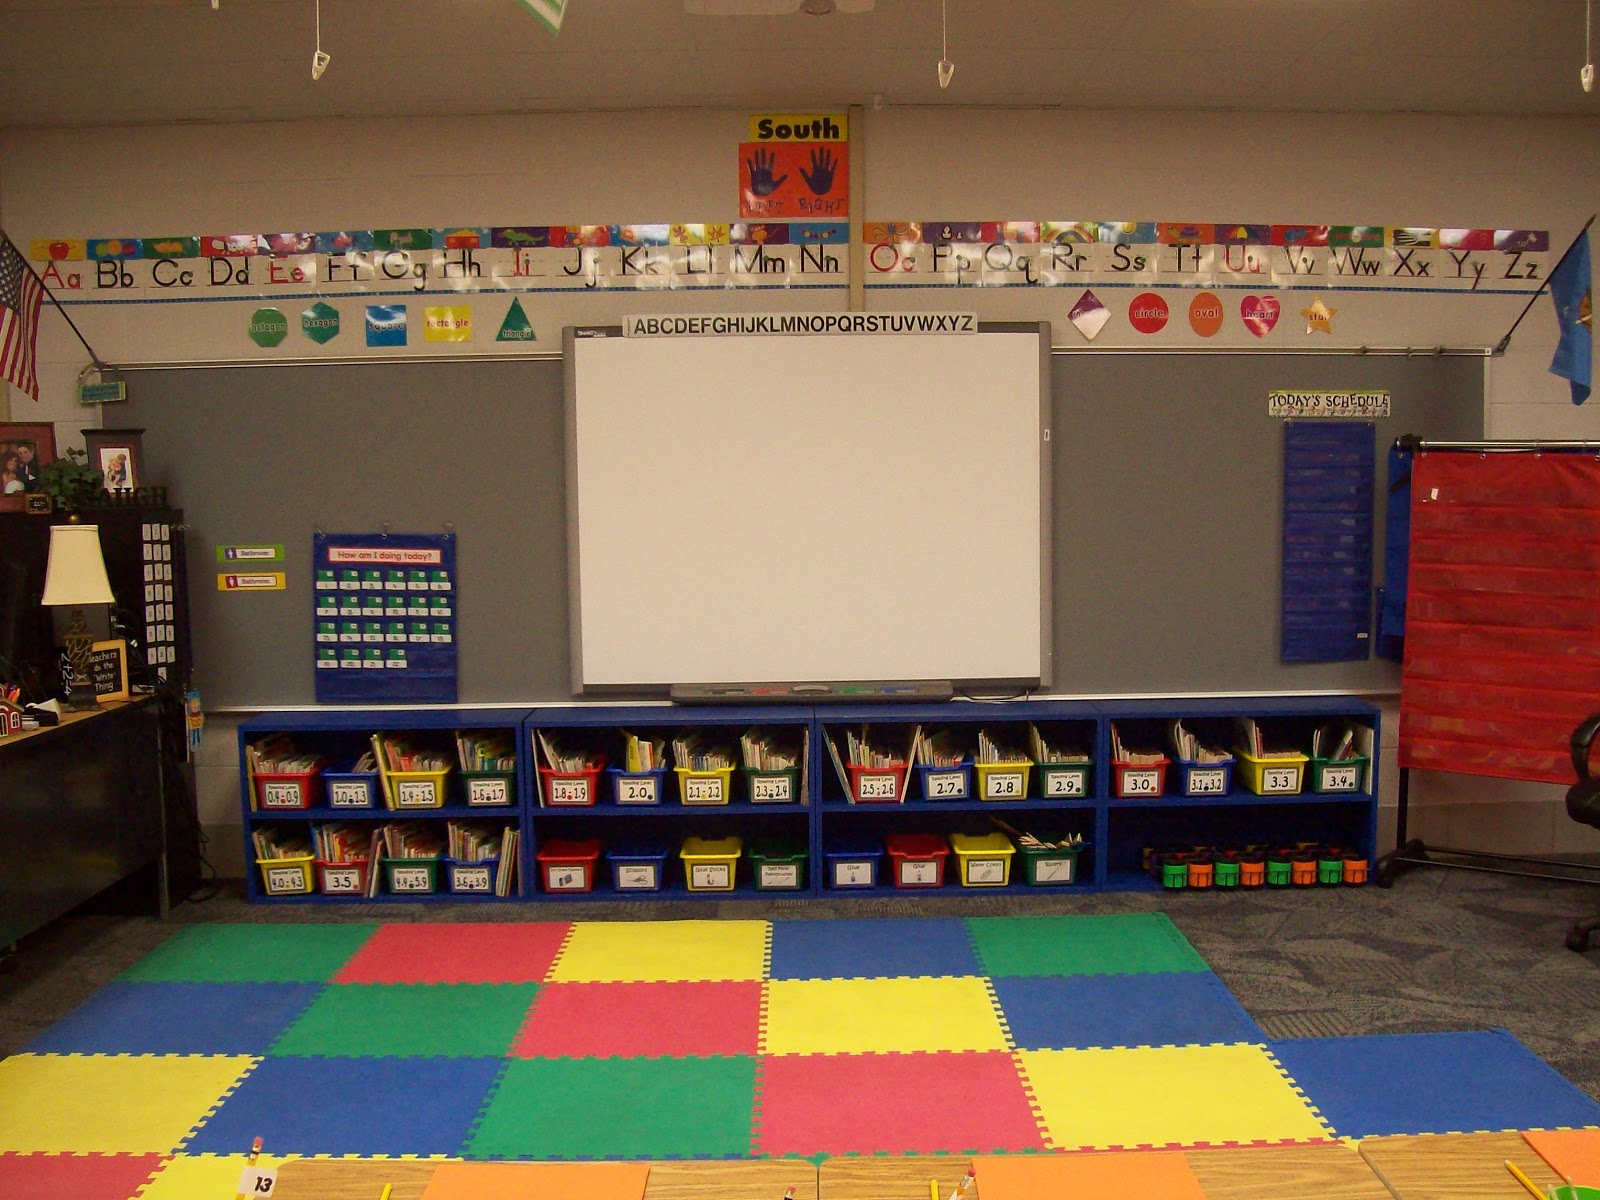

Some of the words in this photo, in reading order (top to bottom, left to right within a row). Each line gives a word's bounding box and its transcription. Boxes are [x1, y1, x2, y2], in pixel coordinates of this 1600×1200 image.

[758, 117, 839, 139] South
[42, 260, 81, 288] Aa
[97, 259, 134, 288] Bb
[152, 258, 193, 287] Cc
[210, 256, 249, 285] Dd
[270, 255, 305, 284] Ee
[382, 251, 427, 291] Gg
[443, 249, 481, 277] Hh
[513, 246, 530, 276] Ii
[563, 246, 599, 288] Jj
[621, 246, 659, 275] Kk
[734, 245, 785, 273] Mm
[800, 244, 839, 273] Nn
[933, 242, 970, 285] Pp
[984, 243, 1038, 284] Qq
[1052, 243, 1087, 271] Rr
[1111, 243, 1146, 271] Ss
[1169, 244, 1203, 272] Tt
[1225, 245, 1260, 273] Uu
[1283, 245, 1315, 274] Vv
[1331, 247, 1380, 275] Ww
[1394, 248, 1430, 276] Xx
[1448, 249, 1485, 289] Yy
[1503, 250, 1538, 278] Zz
[1135, 309, 1165, 319] circle
[1194, 309, 1218, 319] oval
[1246, 310, 1273, 319] heart
[1308, 313, 1329, 321] star
[251, 322, 286, 334] octagon
[303, 319, 338, 328] hexagon
[369, 322, 406, 332] square
[427, 318, 469, 329] rectangle
[634, 315, 973, 335] ABCDEFGHIJKLMNOPQRSTUVWXYZ
[503, 330, 532, 340] triangle
[1269, 394, 1321, 407] TODAY'S
[1326, 393, 1390, 408] SCHEDULE
[337, 551, 356, 559] How
[379, 552, 401, 561] doing
[404, 552, 432, 561] today?
[90, 652, 118, 663] eachers
[95, 682, 114, 692] Thing
[1055, 780, 1074, 792] 2.9
[1131, 779, 1150, 791] 3.0
[1270, 776, 1289, 788] 3.3
[1329, 775, 1347, 787] 3.4
[554, 787, 567, 799] 1.8
[573, 787, 586, 799] 1.9
[628, 787, 648, 799] 2.0
[688, 786, 701, 799] 2.1
[708, 786, 720, 799] 2.2
[862, 784, 875, 795] 2.5
[882, 783, 894, 795] 2.6
[937, 782, 956, 794] 2.7
[995, 781, 1014, 794] 2.8
[333, 877, 352, 888] 3.5
[255, 1176, 273, 1193] 13
